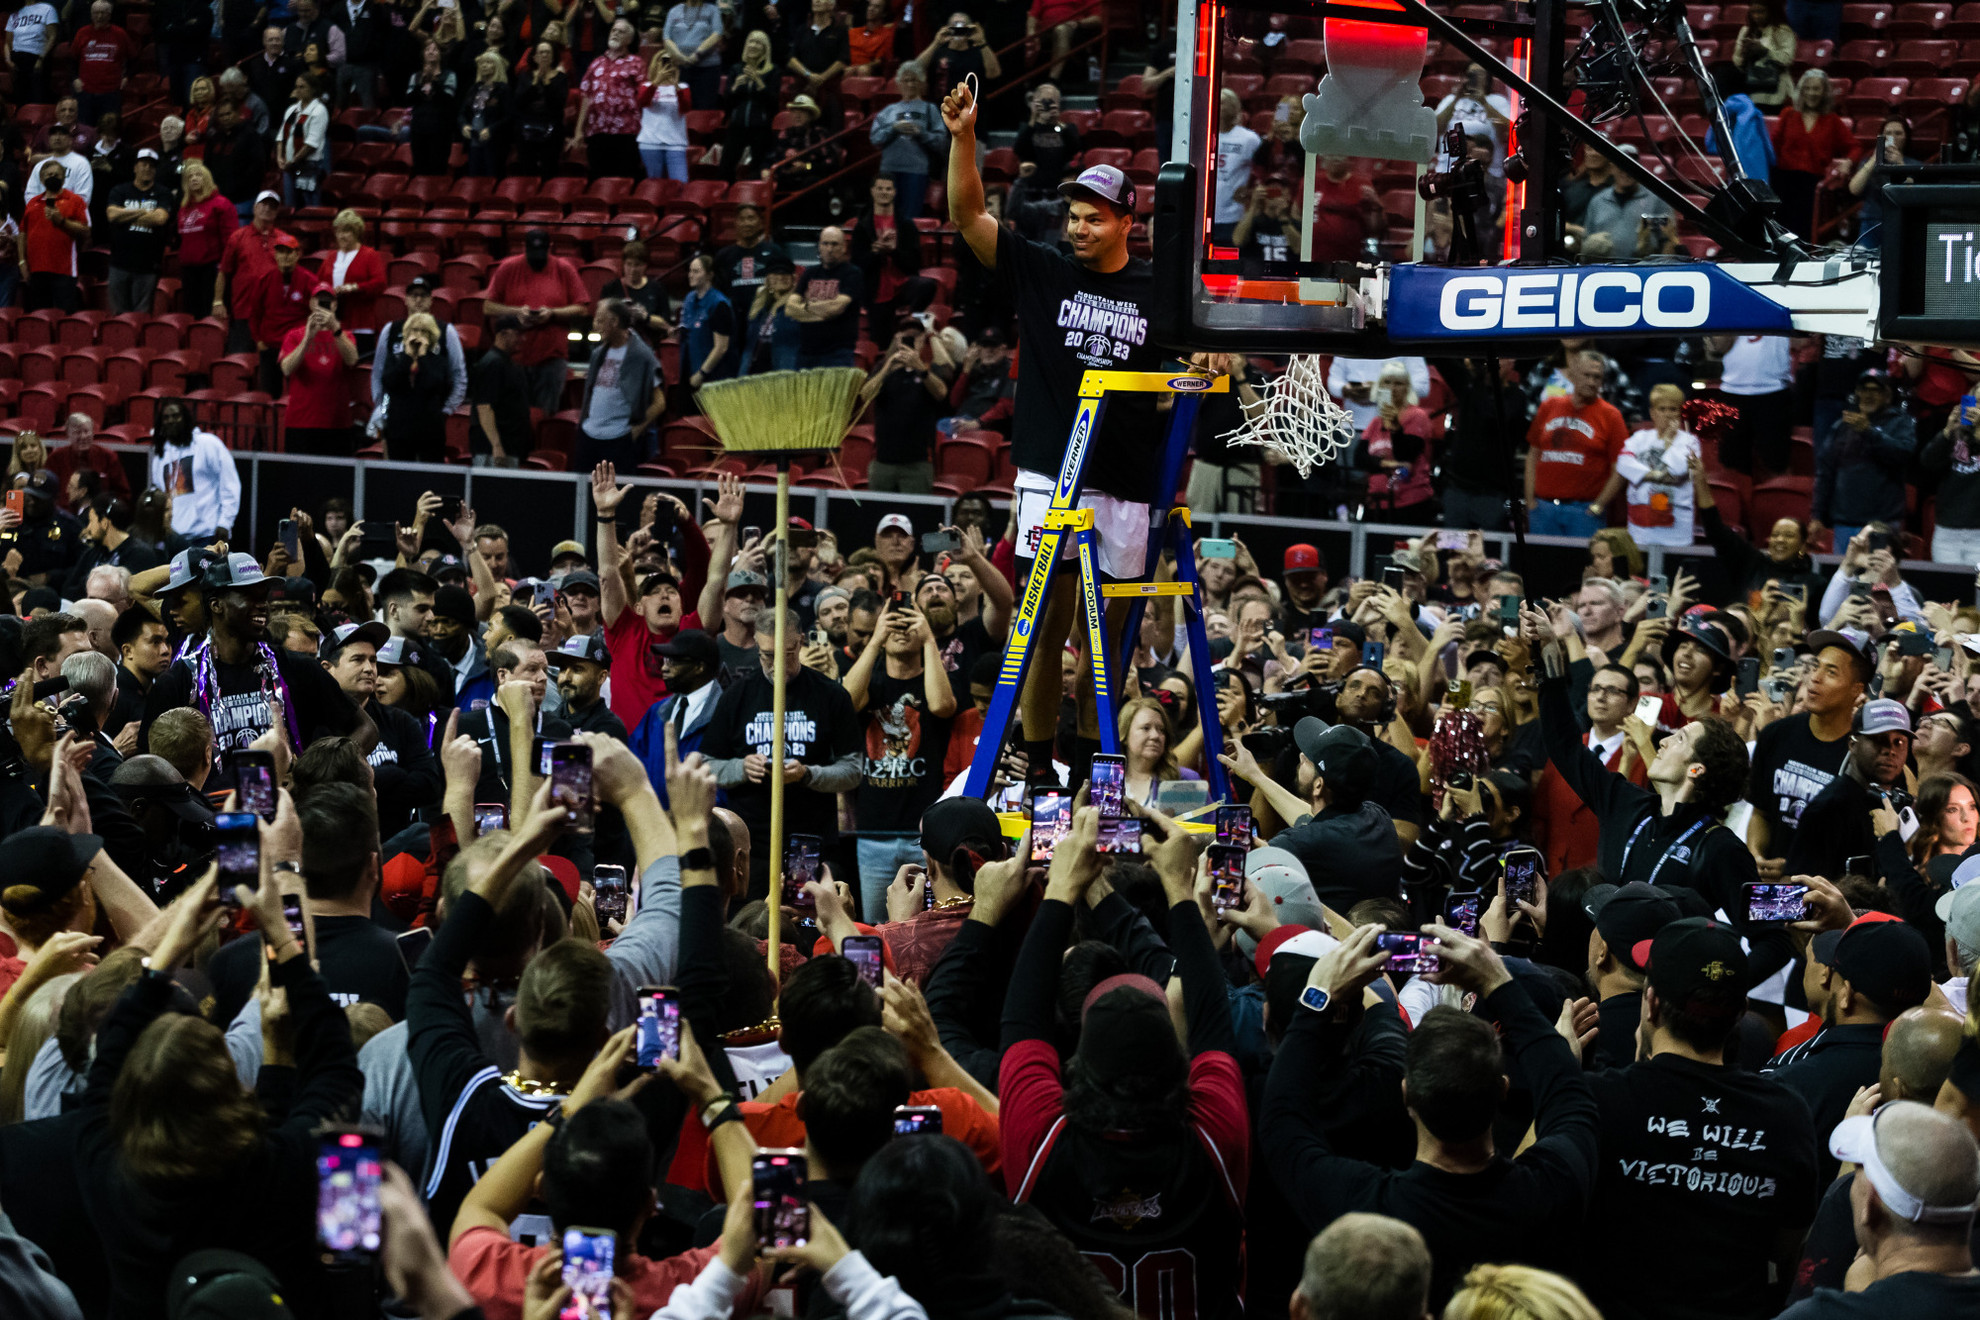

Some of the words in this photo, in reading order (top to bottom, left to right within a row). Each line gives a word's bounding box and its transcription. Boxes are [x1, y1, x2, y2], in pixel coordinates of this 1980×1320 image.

[1077, 290, 1115, 305] MOUNTAIN
[1116, 300, 1138, 309] WEST
[1439, 271, 1711, 331] GEICO
[1057, 299, 1148, 346] CHAMPIONS
[1064, 331, 1084, 347] 20
[1112, 340, 1130, 361] 23
[1176, 380, 1204, 388] WERNER
[1065, 425, 1086, 481] WERNER
[1023, 541, 1054, 619] BASKETBALL
[1085, 582, 1099, 630] PODIUM
[218, 733, 234, 751] 20
[756, 743, 770, 756] 20
[792, 742, 806, 756] 23
[863, 757, 926, 779] AZTEC
[1647, 1116, 1690, 1137] WE
[1703, 1124, 1767, 1151] WILL
[1691, 1147, 1718, 1161] BE
